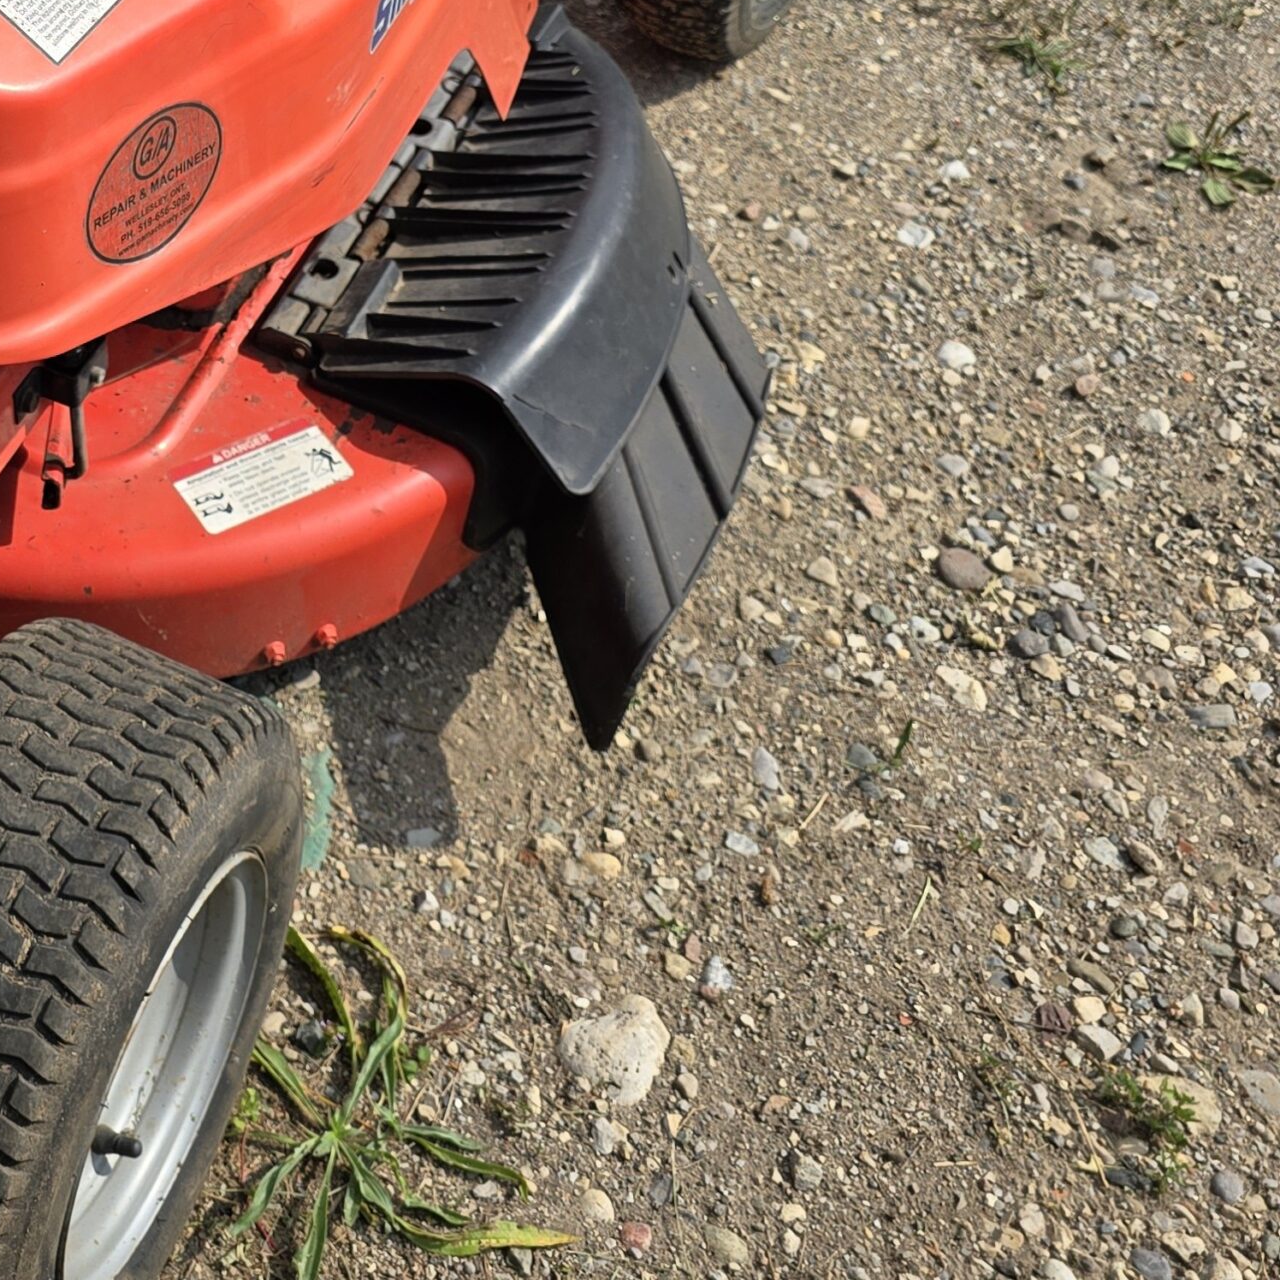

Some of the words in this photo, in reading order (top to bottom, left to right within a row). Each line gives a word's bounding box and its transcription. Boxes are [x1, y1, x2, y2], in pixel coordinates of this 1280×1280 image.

[94, 194, 136, 231] REPAIR
[139, 187, 147, 201] &
[150, 141, 217, 193] MACHINERY
[221, 432, 272, 459] DANGER
